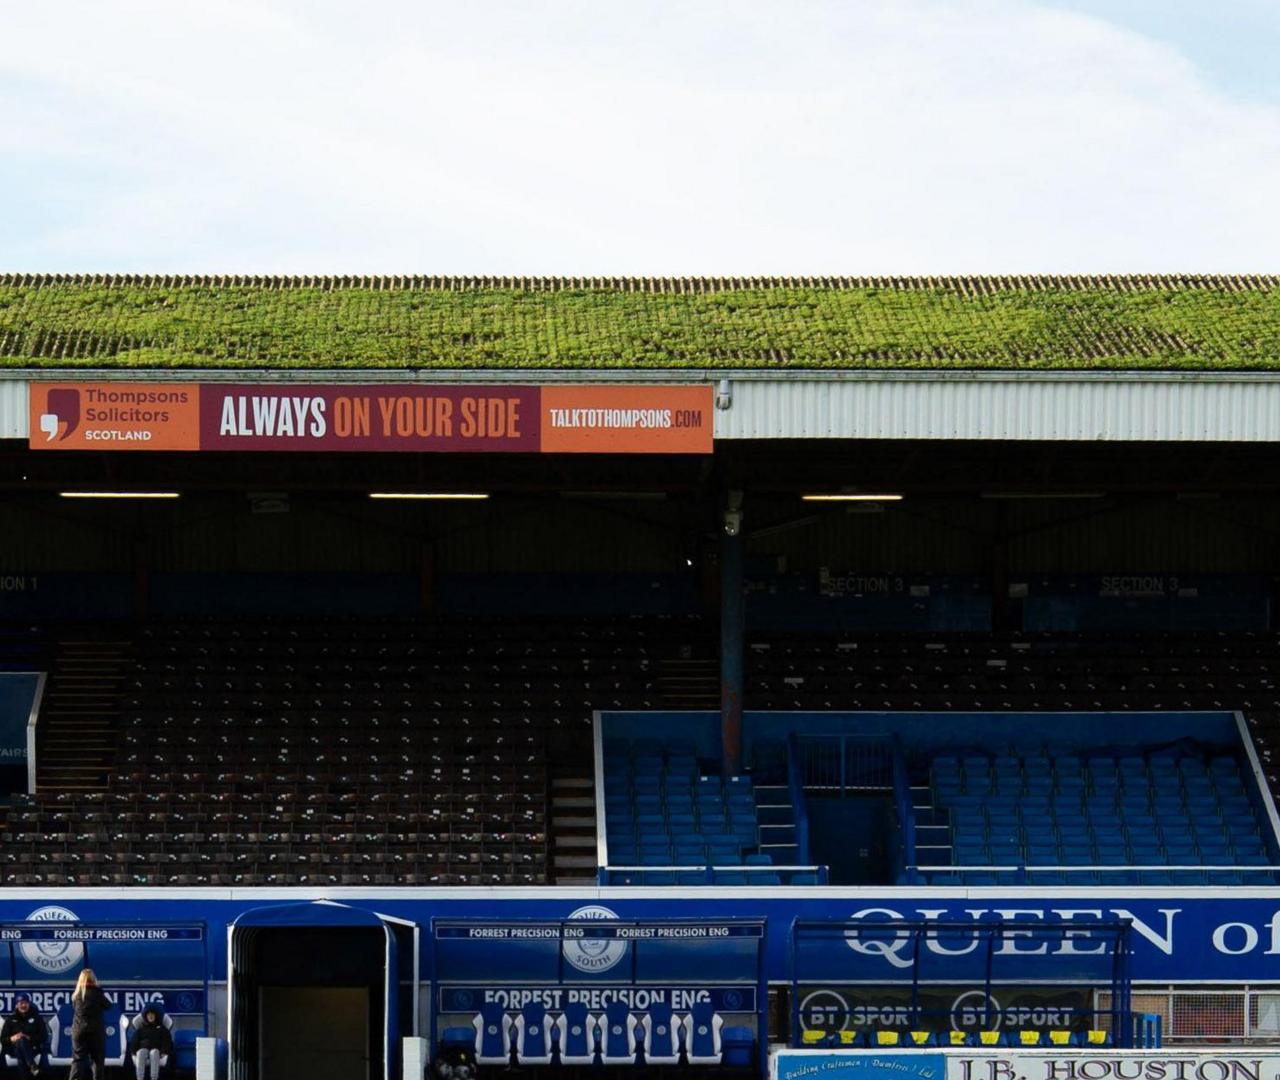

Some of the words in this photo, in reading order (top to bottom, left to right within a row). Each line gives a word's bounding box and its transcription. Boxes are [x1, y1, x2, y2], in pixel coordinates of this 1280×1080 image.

[85, 389, 188, 407] Thompsons
[85, 408, 169, 423] Solicitors
[220, 396, 326, 437] ALWAYS
[334, 397, 369, 437] ON
[377, 397, 451, 437] YOUR
[459, 397, 521, 438] SIDE
[550, 407, 702, 428] TALKTOTHOMPSONS.COM
[85, 431, 151, 442] SCOTLAND
[1102, 576, 1163, 592] SECTION
[2, 930, 22, 940] ENG
[54, 930, 94, 940] FORREST
[96, 930, 145, 940] PRECISION
[147, 930, 168, 940] ENG
[469, 929, 510, 938] FORREST
[511, 928, 560, 938] PRECISION
[564, 928, 584, 937] ENG
[616, 928, 657, 938] FORREST
[657, 928, 707, 937] PRECISION
[709, 927, 729, 937] ENG
[844, 907, 1180, 968] QUEEN
[34, 956, 70, 969] SOUTH
[576, 955, 612, 967] SOUTH
[810, 1006, 838, 1026] BT
[1005, 1006, 1073, 1026] SPORT
